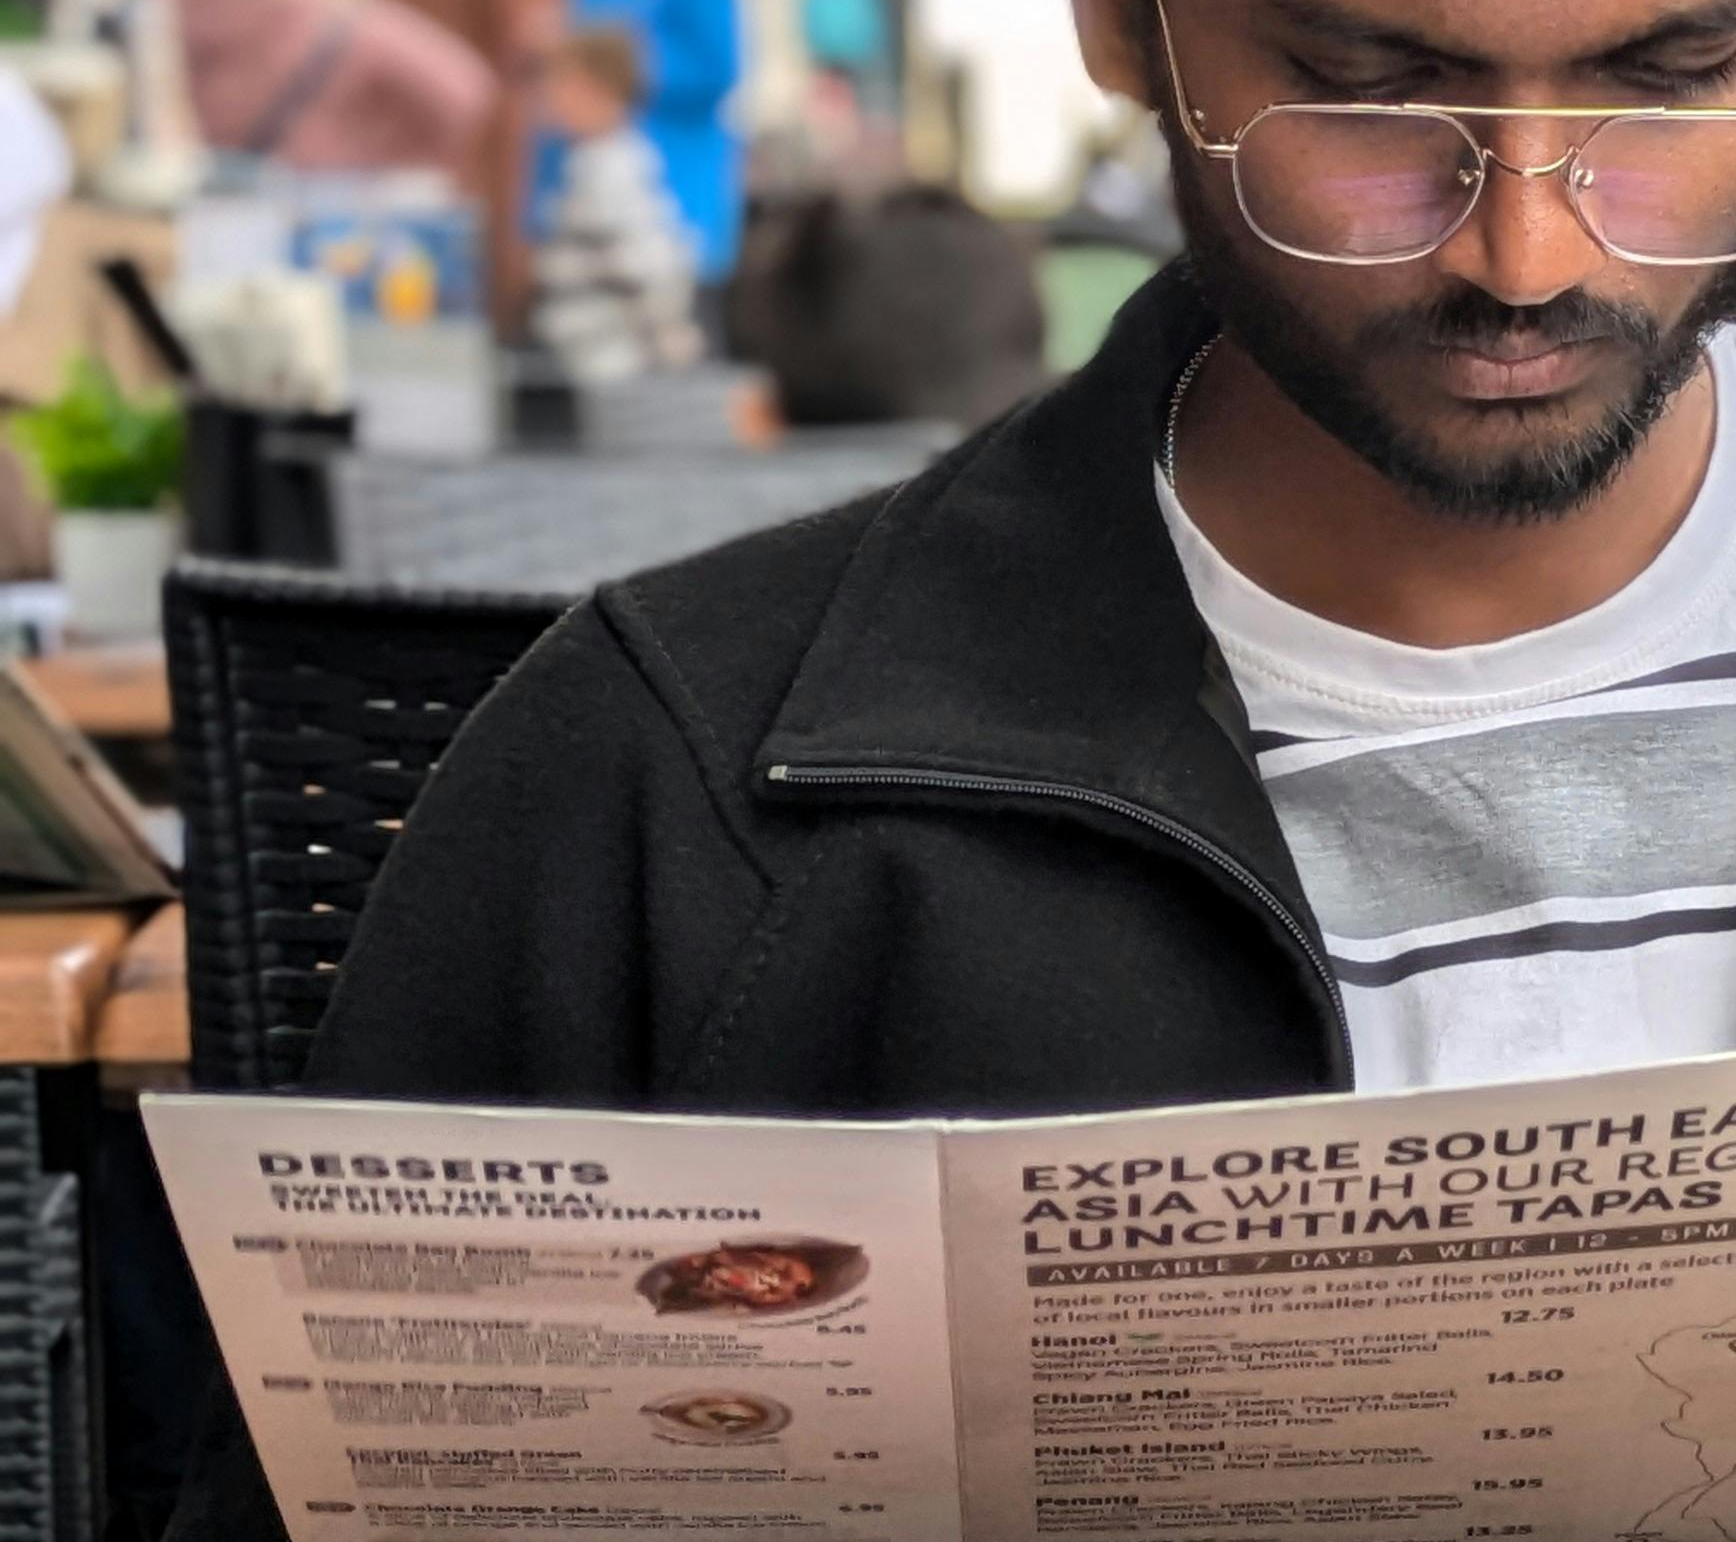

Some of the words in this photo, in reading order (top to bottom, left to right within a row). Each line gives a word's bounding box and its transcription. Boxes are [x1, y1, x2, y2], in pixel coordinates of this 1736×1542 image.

[1022, 1141, 1360, 1192] EXPLORE
[1384, 1114, 1646, 1167] SOUTH
[257, 1153, 610, 1186] DESSERTS
[270, 1184, 428, 1201] SWEETEN
[443, 1188, 502, 1203] THE
[1021, 1192, 1199, 1225] ASIA
[1222, 1172, 1414, 1210] WITH
[1438, 1158, 1594, 1197] OUR
[277, 1199, 337, 1213] THE
[345, 1201, 514, 1217] ULTIMATE
[524, 1206, 762, 1222] DESTINATION
[1023, 1202, 1476, 1255] LUNCHTIME
[1496, 1180, 1724, 1225] TAPAS
[1047, 1256, 1229, 1283] AVAILABLE
[1290, 1248, 1375, 1269] DAYS
[1395, 1245, 1416, 1262] A
[1437, 1237, 1527, 1261] WEEK
[1577, 1231, 1608, 1252] 12
[1660, 1221, 1731, 1244] 5PM
[1032, 1289, 1105, 1309] Made
[1112, 1288, 1148, 1306] for
[1157, 1289, 1215, 1306] one,
[1222, 1283, 1295, 1304] enjoy
[1301, 1283, 1318, 1297] a
[1323, 1277, 1390, 1295] taste
[1396, 1273, 1426, 1290] of
[1432, 1270, 1474, 1289] the
[1481, 1267, 1566, 1289] region
[1572, 1259, 1631, 1278] with
[1636, 1260, 1653, 1273] a
[1032, 1308, 1062, 1326] of
[1066, 1304, 1132, 1325] local
[1136, 1301, 1244, 1322] flavours
[1249, 1298, 1270, 1315] in
[1280, 1292, 1377, 1314] smaller
[1383, 1288, 1495, 1310] portions
[1500, 1285, 1534, 1300] on
[1540, 1277, 1605, 1298] each
[1607, 1273, 1675, 1296] plate
[1500, 1305, 1576, 1325] 12.75
[1031, 1333, 1117, 1348] Hanoi
[1485, 1368, 1565, 1386] 14.50
[1032, 1391, 1133, 1406] Chiang
[1141, 1387, 1191, 1402] Mai
[1481, 1425, 1554, 1441] 13.95
[1034, 1443, 1134, 1458] Phuket
[1140, 1439, 1226, 1455] Island
[1035, 1494, 1140, 1508] Penang
